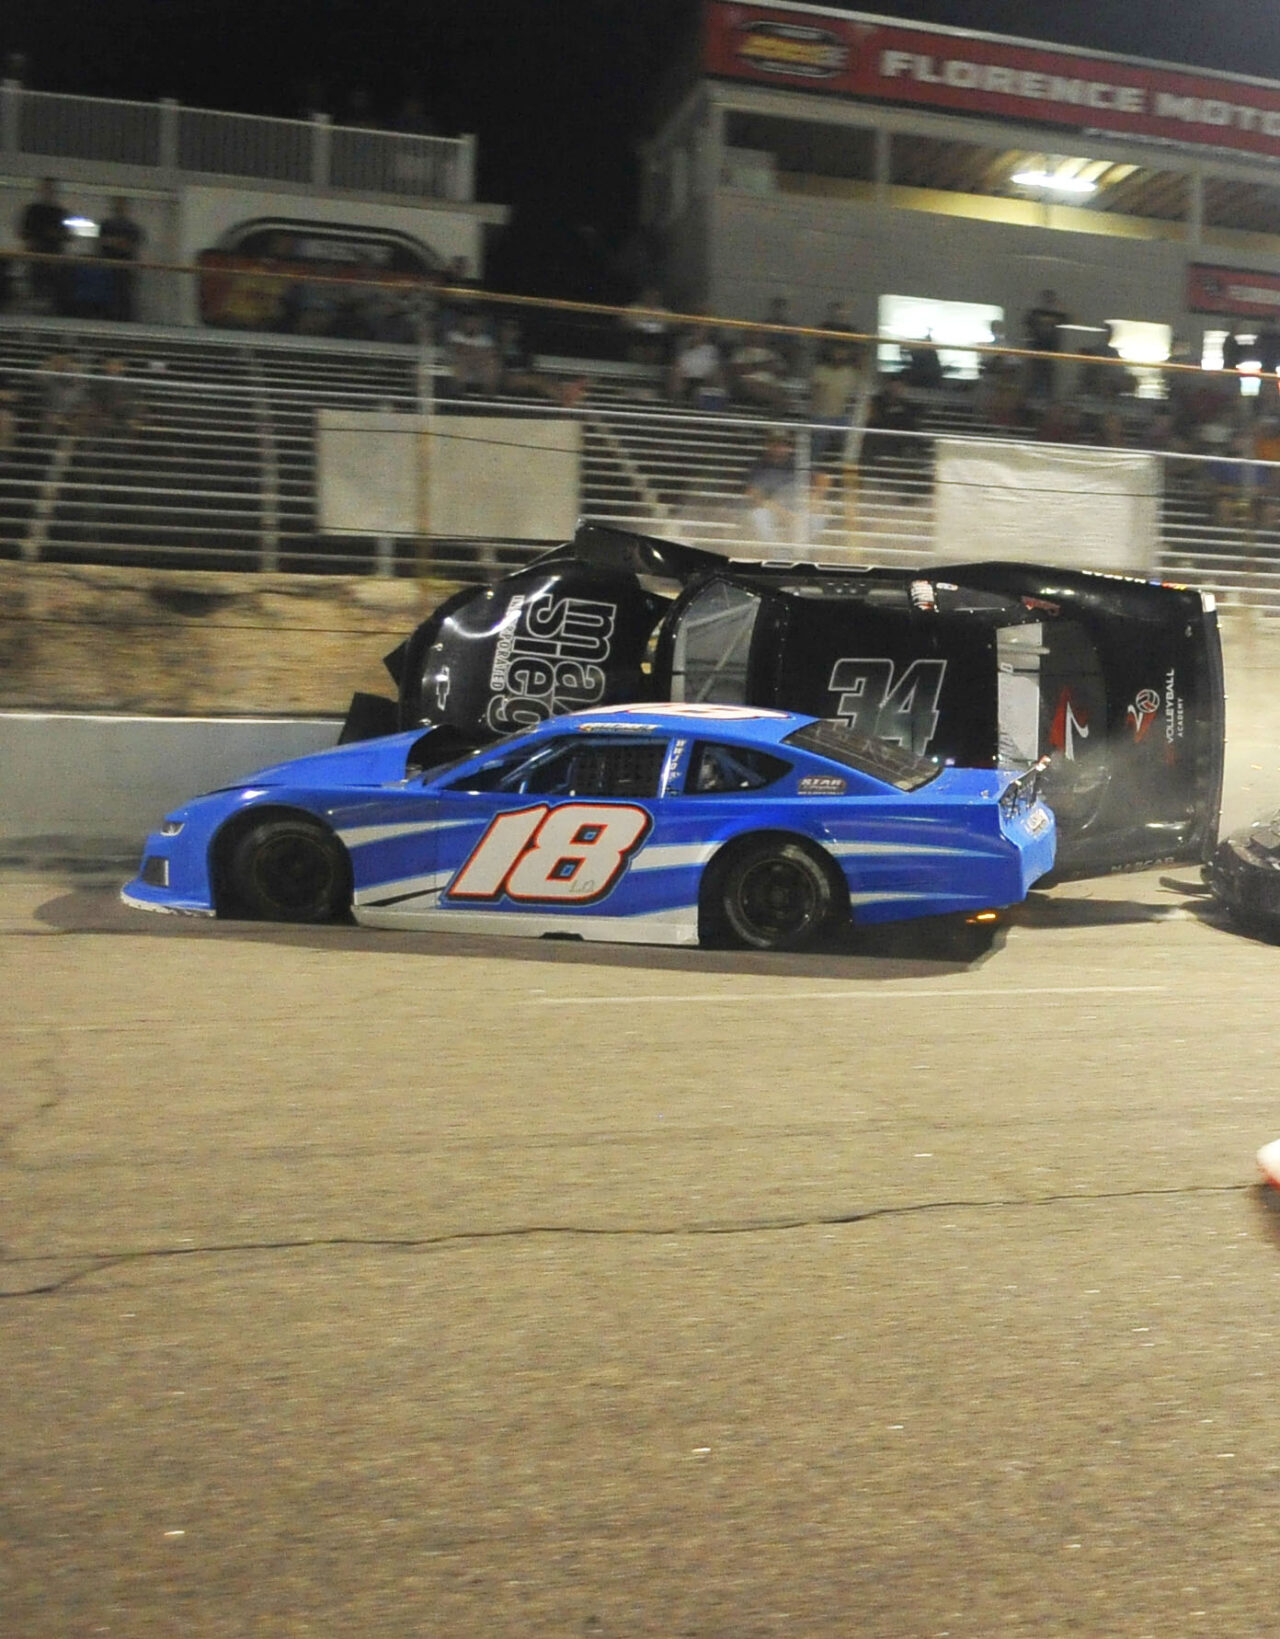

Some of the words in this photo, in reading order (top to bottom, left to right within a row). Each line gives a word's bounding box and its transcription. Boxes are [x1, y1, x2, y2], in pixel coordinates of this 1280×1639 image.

[880, 49, 1145, 114] FLORENCE
[490, 594, 526, 691] INRPORATED
[550, 597, 617, 716] ma
[820, 657, 948, 764] 34
[1165, 668, 1175, 744] VOLLEYBALL
[445, 802, 654, 904] 18
